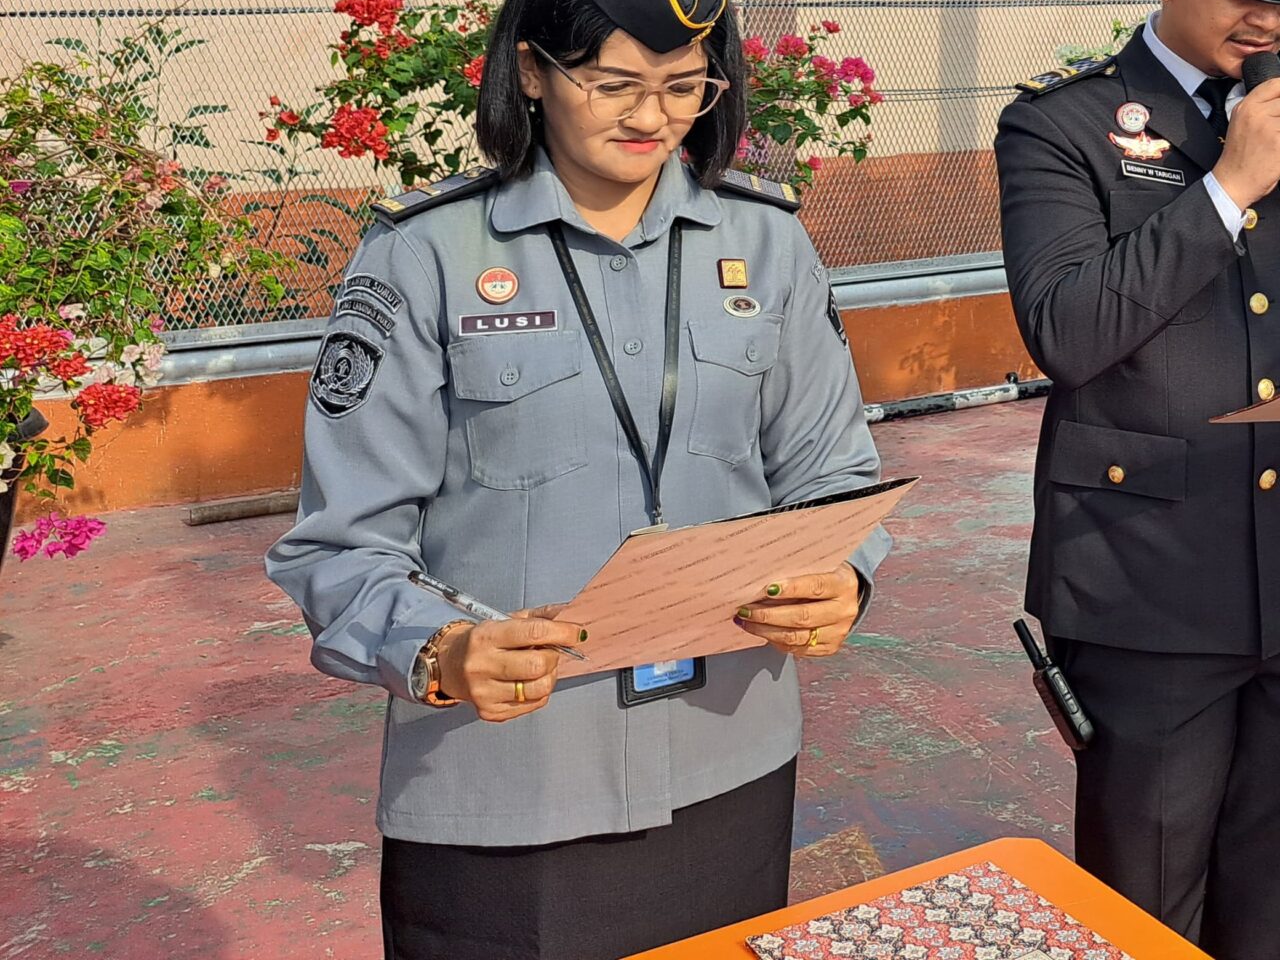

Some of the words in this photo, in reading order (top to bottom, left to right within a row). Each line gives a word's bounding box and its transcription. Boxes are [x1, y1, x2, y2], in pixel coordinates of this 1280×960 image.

[1154, 170, 1181, 180] TARIGAN
[373, 281, 399, 308] SUMUT
[476, 315, 541, 330] LUSI
